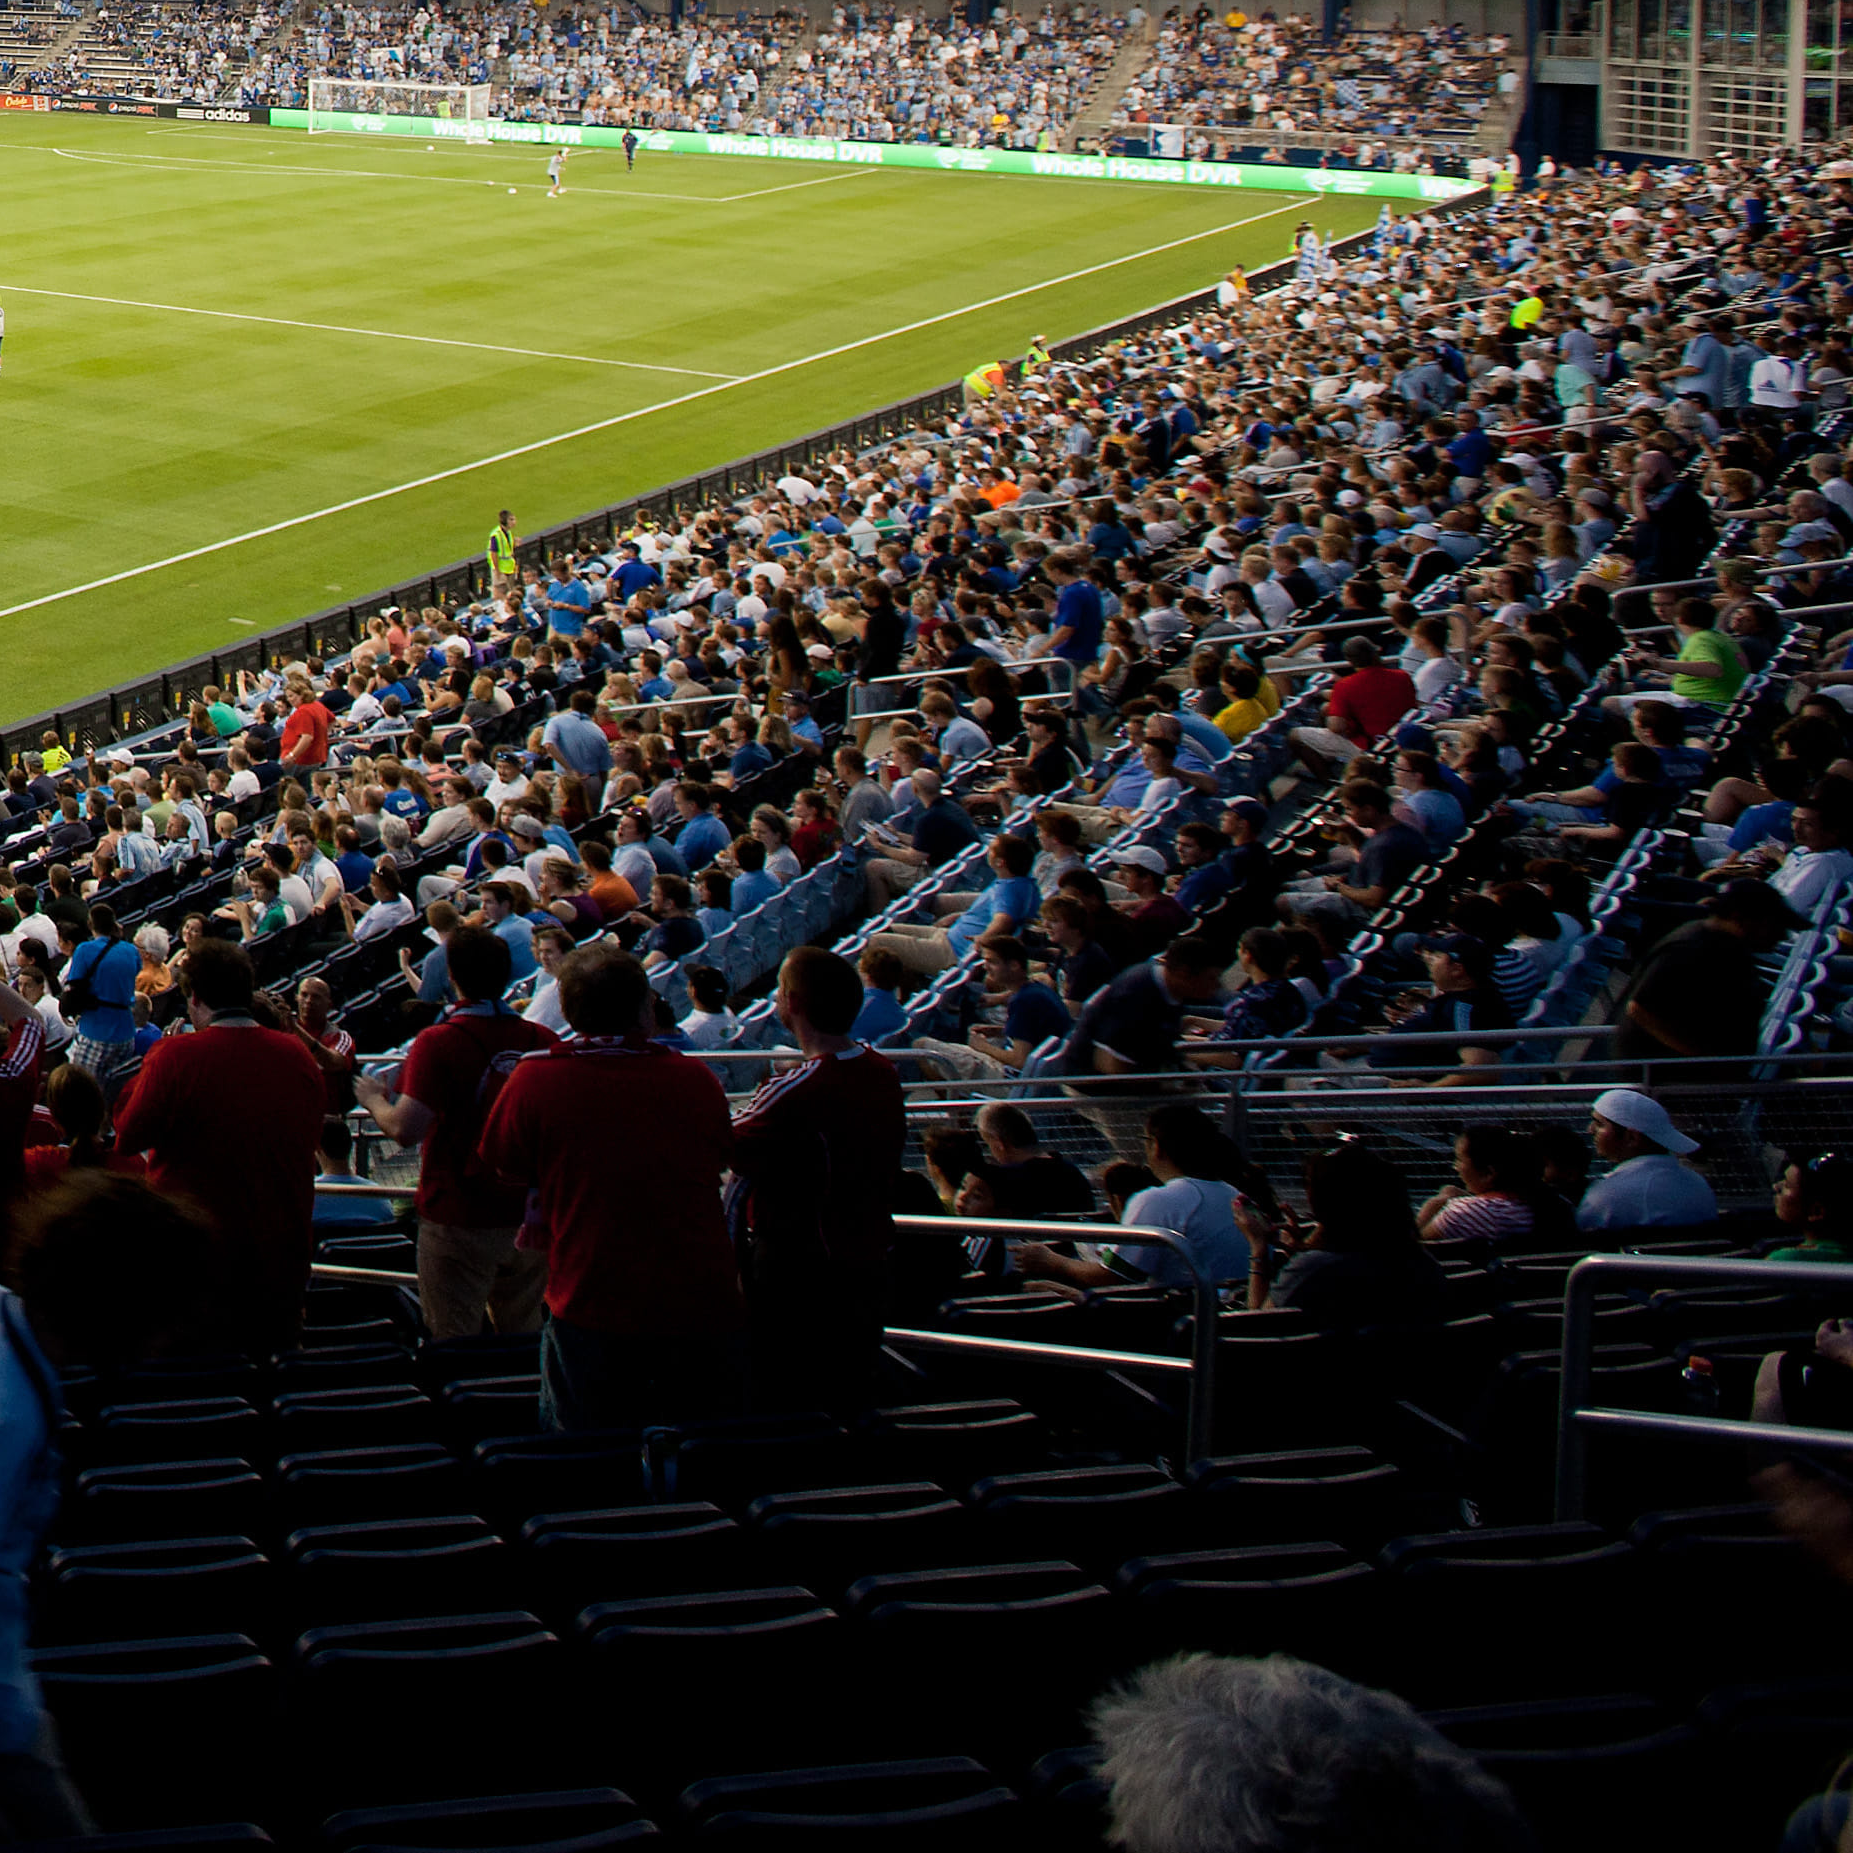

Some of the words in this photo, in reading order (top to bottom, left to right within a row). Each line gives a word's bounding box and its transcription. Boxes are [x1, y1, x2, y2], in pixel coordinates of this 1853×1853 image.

[204, 109, 250, 123] adidas
[488, 123, 542, 142] House
[544, 125, 582, 144] DVR
[706, 135, 769, 155] Whole
[773, 139, 836, 159] House
[838, 142, 883, 163] DVR
[1031, 155, 1104, 177] Whole
[1109, 158, 1184, 182] House
[1188, 162, 1242, 186] DVR
